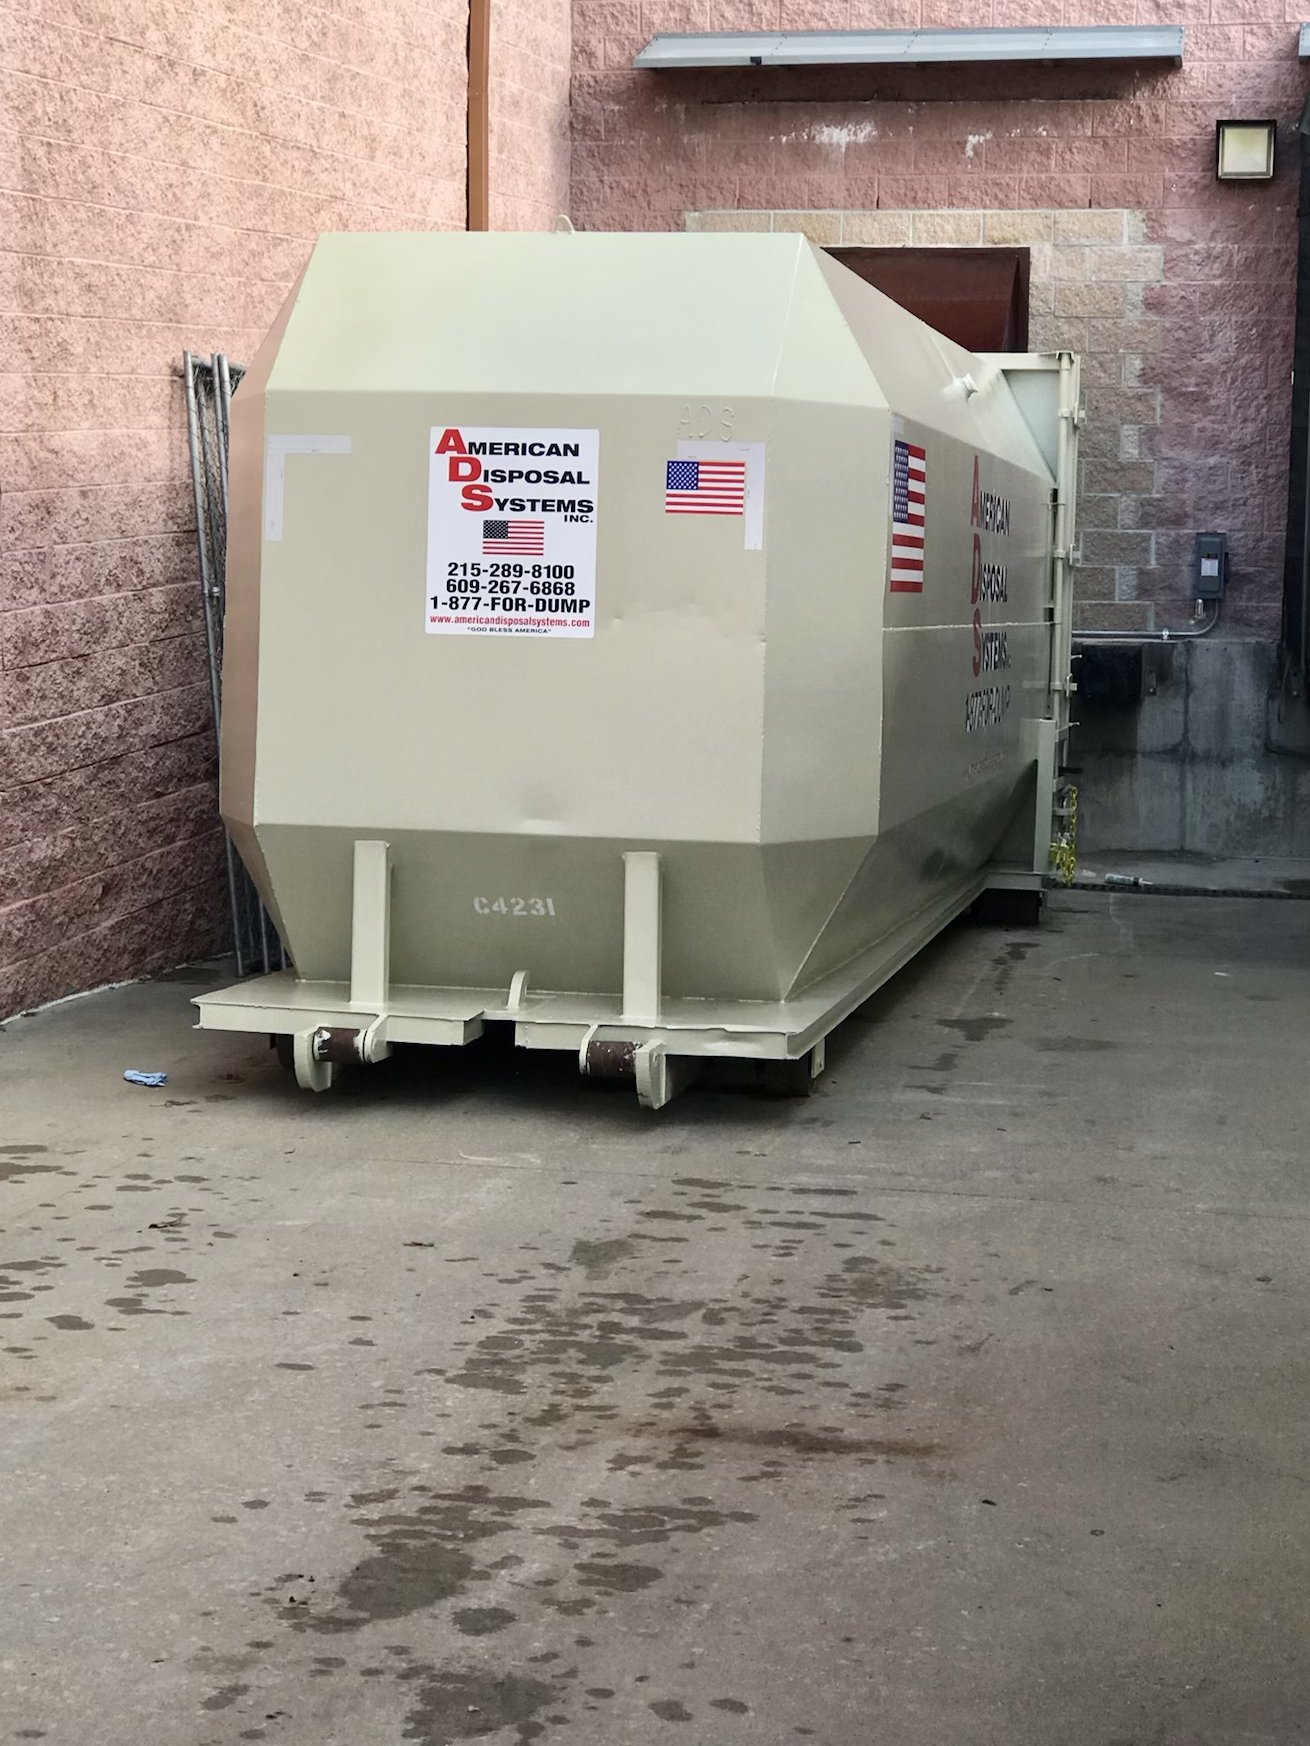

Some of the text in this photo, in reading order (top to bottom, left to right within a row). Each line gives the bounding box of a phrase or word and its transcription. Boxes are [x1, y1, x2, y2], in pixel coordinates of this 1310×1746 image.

[435, 428, 580, 457] AMERICAN
[448, 456, 590, 485] DISPOSAL
[461, 484, 594, 513] SYSTEMS
[564, 514, 593, 523] INC.
[447, 562, 575, 579] 215-289-8100
[446, 579, 575, 596] 609-267-6868
[430, 596, 591, 613] 1-877-FOR-DUMP
[430, 615, 590, 628] www.americandisposalsystems.com
[473, 896, 555, 916] C4231
